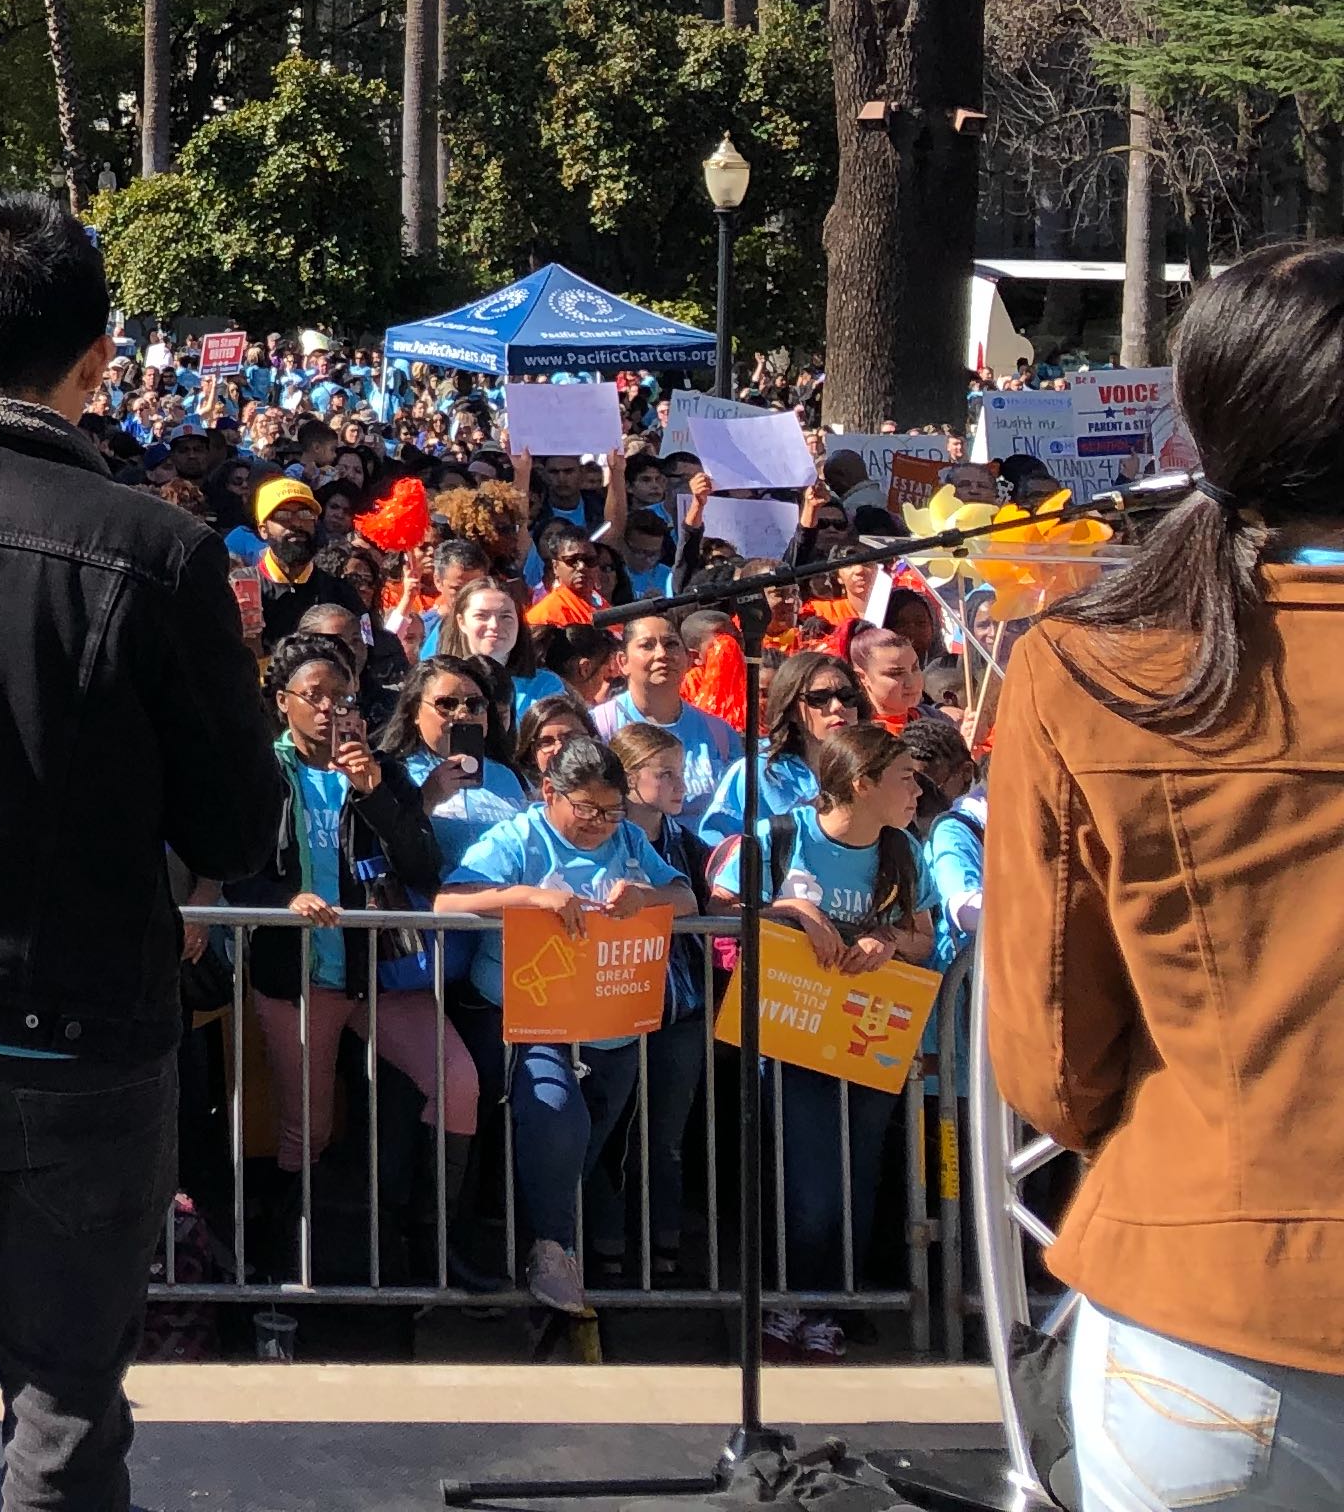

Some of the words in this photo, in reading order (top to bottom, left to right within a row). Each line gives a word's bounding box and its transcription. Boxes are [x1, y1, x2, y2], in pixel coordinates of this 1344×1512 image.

[540, 330, 579, 339] Pacific
[579, 329, 622, 338] Charter
[624, 327, 677, 337] Institute
[393, 340, 498, 371] www.PacificCharters.org
[524, 348, 717, 367] www.PacificCharters.org
[1098, 383, 1160, 405] VOICE
[994, 415, 1033, 435] taught
[1088, 420, 1124, 433] PARENT
[597, 935, 665, 967] DEFEND
[596, 968, 637, 983] GREAT
[767, 968, 832, 998] FUNDING
[595, 980, 651, 998] SCHOOLS
[792, 989, 828, 1011] FULL
[759, 997, 823, 1035] DEMA
